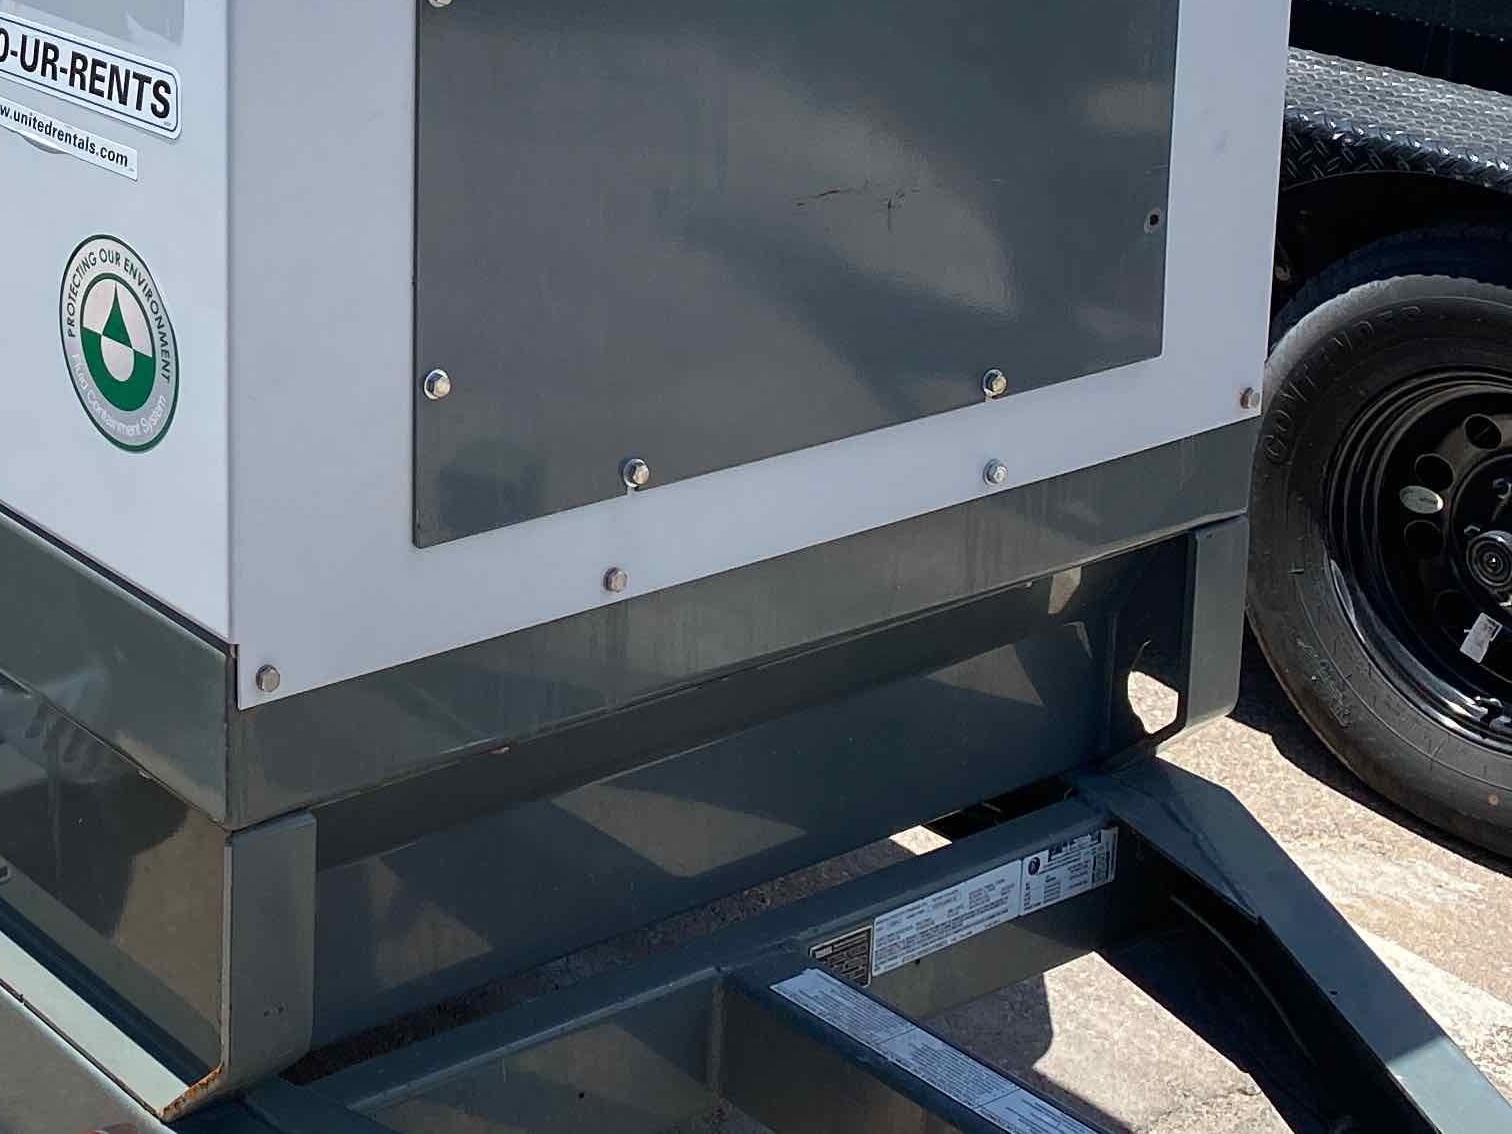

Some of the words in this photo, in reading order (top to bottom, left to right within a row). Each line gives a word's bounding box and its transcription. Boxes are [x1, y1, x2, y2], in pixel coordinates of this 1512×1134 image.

[67, 251, 97, 339] PROTECTING
[98, 248, 121, 266] OUR
[123, 258, 172, 384] ENVIRONMENT
